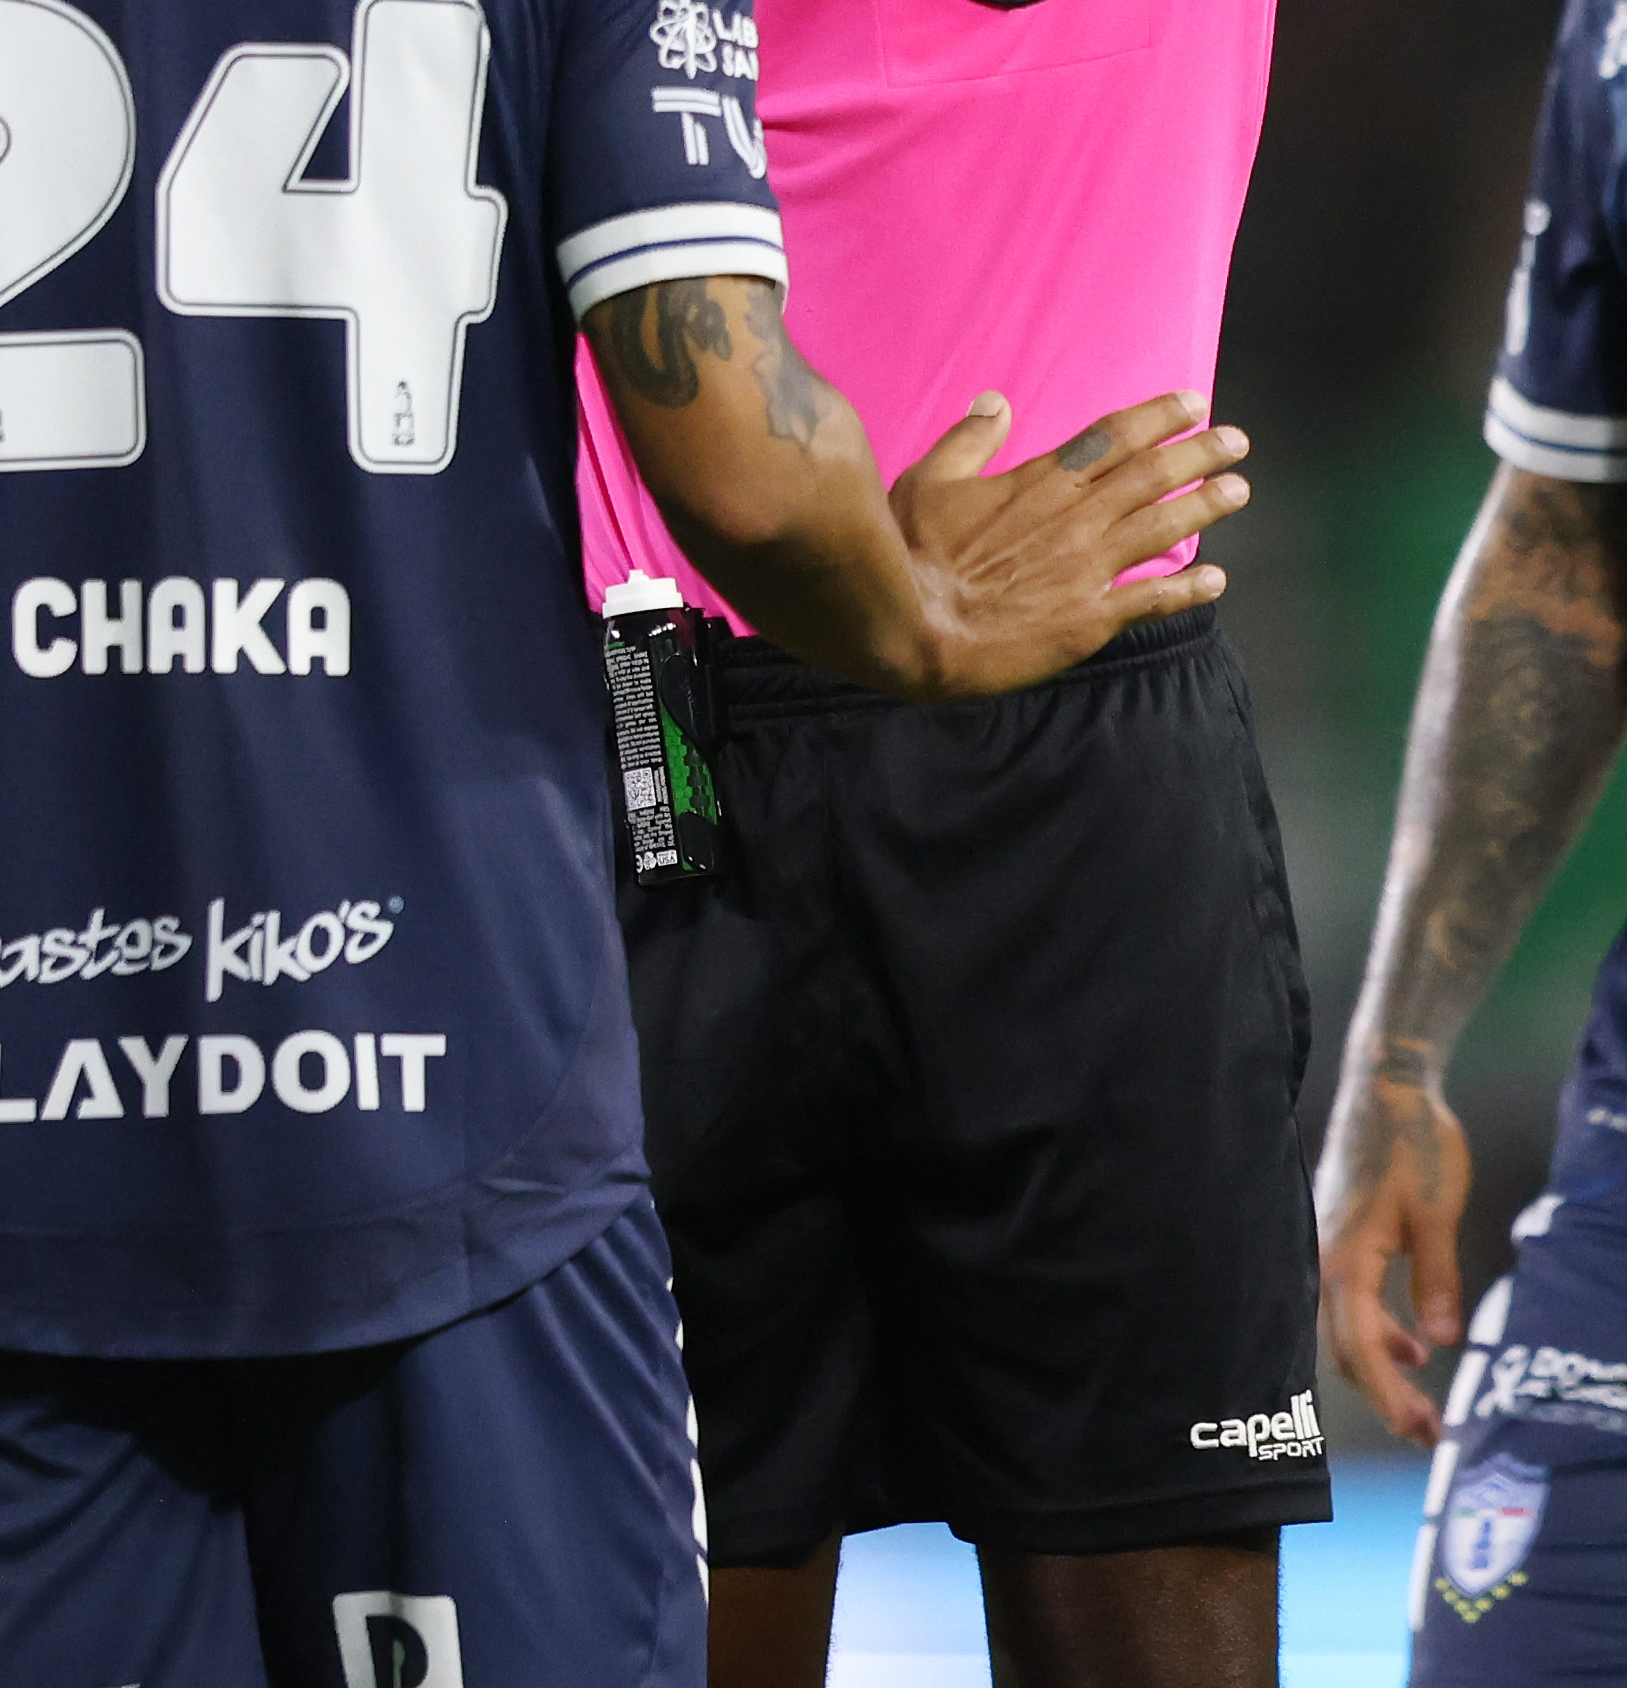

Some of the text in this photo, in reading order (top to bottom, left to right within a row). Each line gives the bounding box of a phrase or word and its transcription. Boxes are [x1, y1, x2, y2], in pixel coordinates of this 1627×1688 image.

[11, 576, 351, 678] CHAKA
[206, 898, 395, 1002] kiko's
[1189, 1389, 1321, 1458] capelli
[1258, 1436, 1326, 1462] SPORT
